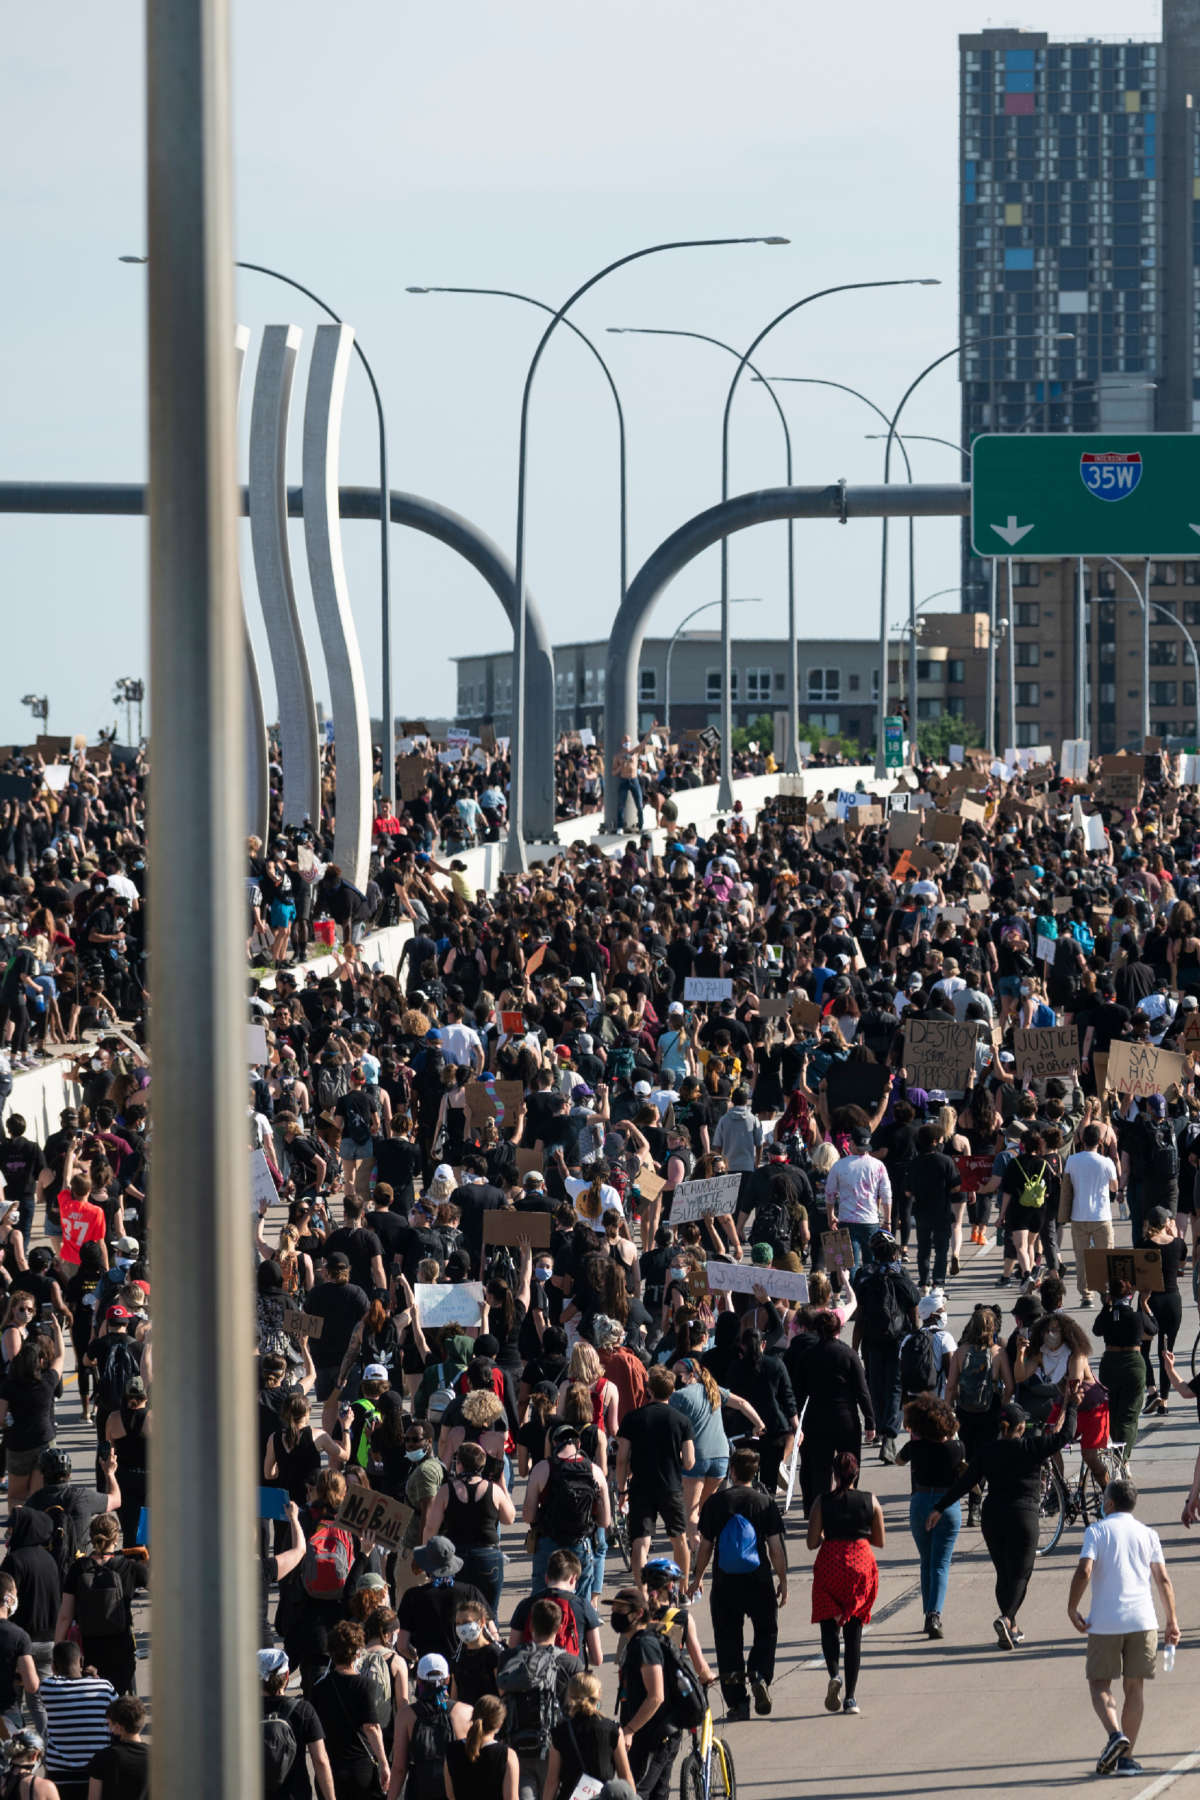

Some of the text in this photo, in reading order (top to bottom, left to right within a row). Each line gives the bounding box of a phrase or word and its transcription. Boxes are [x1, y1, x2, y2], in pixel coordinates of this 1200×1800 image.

[1087, 465, 1134, 489] 35W
[839, 791, 856, 805] NO
[909, 1021, 977, 1049] DESTROY
[1019, 1028, 1078, 1050] JUSTICE
[1129, 1046, 1159, 1068] SAY
[1129, 1066, 1155, 1082] HIS
[1120, 1078, 1161, 1095] NAME
[62, 1218, 88, 1246] 37
